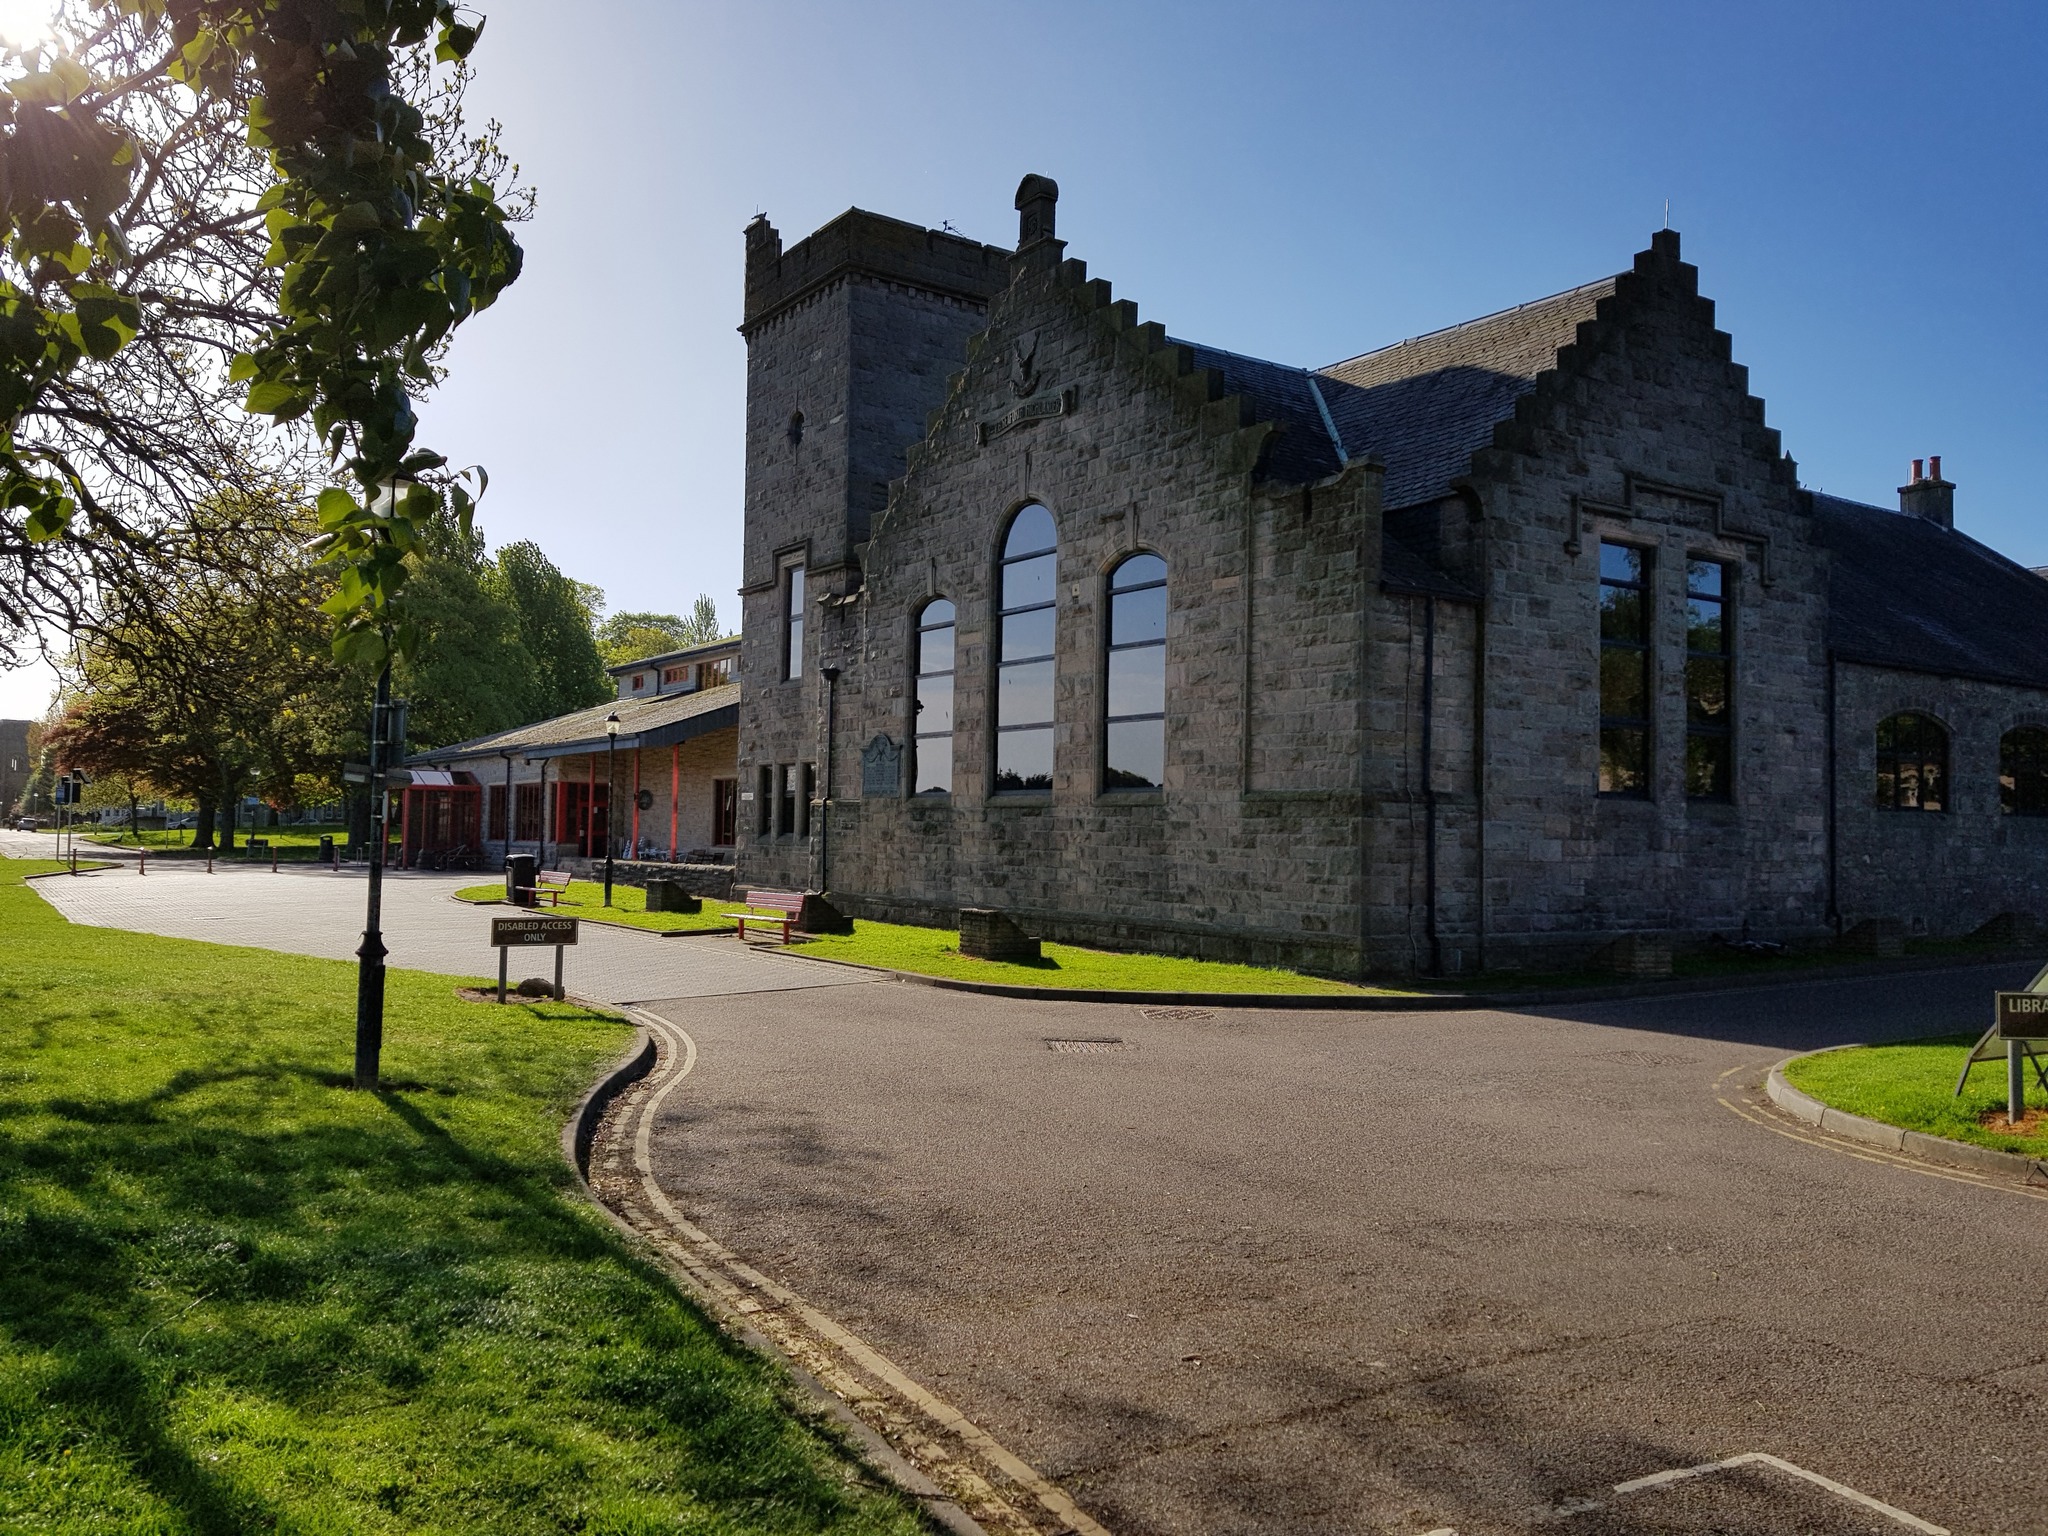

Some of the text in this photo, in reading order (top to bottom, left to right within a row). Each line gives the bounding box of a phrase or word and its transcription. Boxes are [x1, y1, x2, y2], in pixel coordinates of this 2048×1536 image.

[498, 921, 572, 931] DISABLED ACCESS
[524, 933, 546, 942] ONLY
